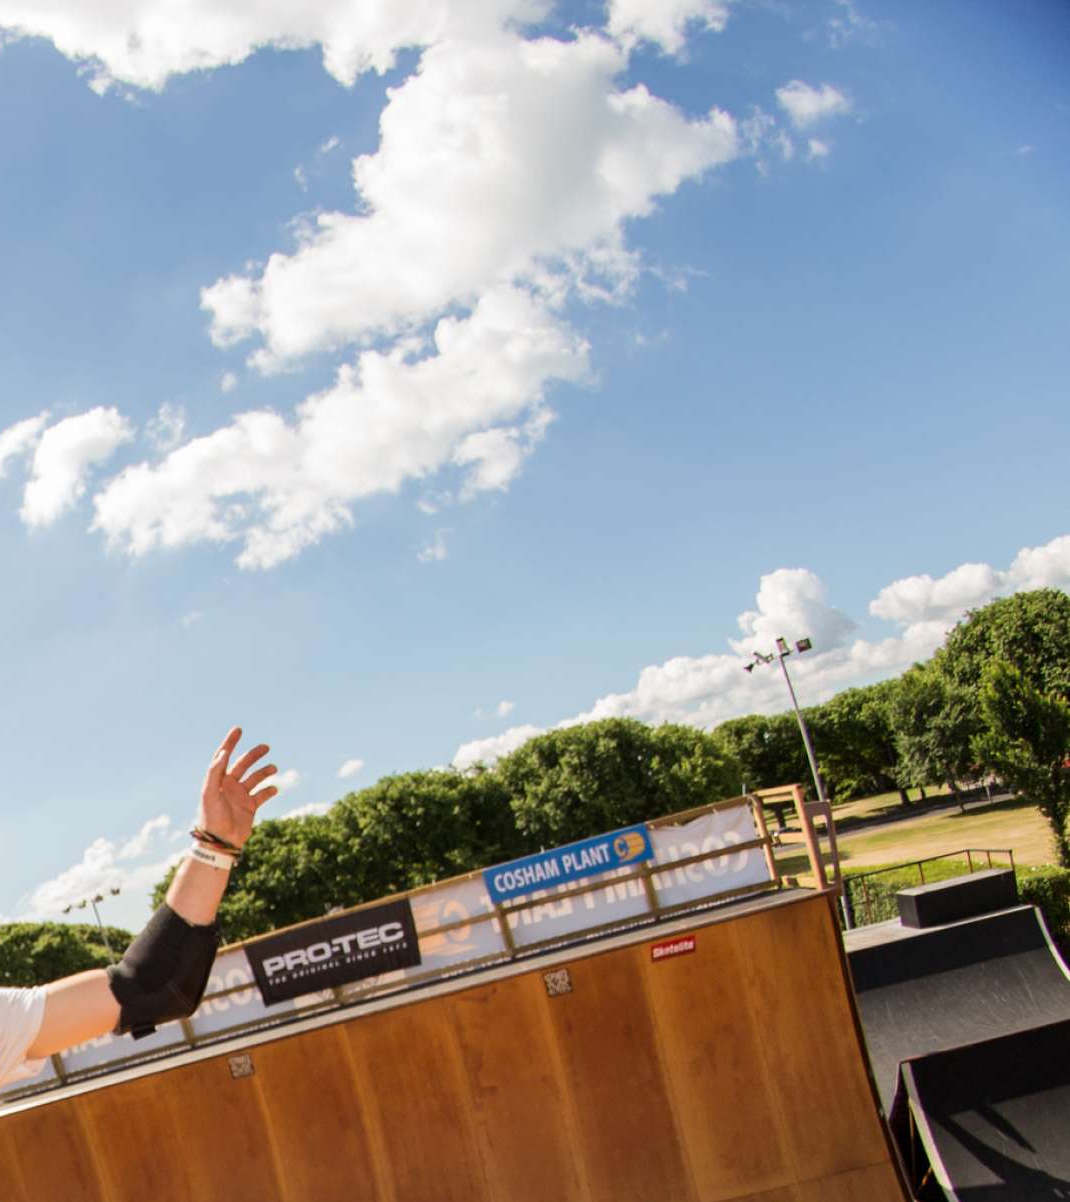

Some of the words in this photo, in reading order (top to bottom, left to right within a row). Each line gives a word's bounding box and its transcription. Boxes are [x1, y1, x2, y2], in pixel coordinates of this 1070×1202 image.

[493, 858, 560, 893] COSHAM
[561, 843, 610, 874] PLANT
[262, 921, 405, 977] PRO-TEC
